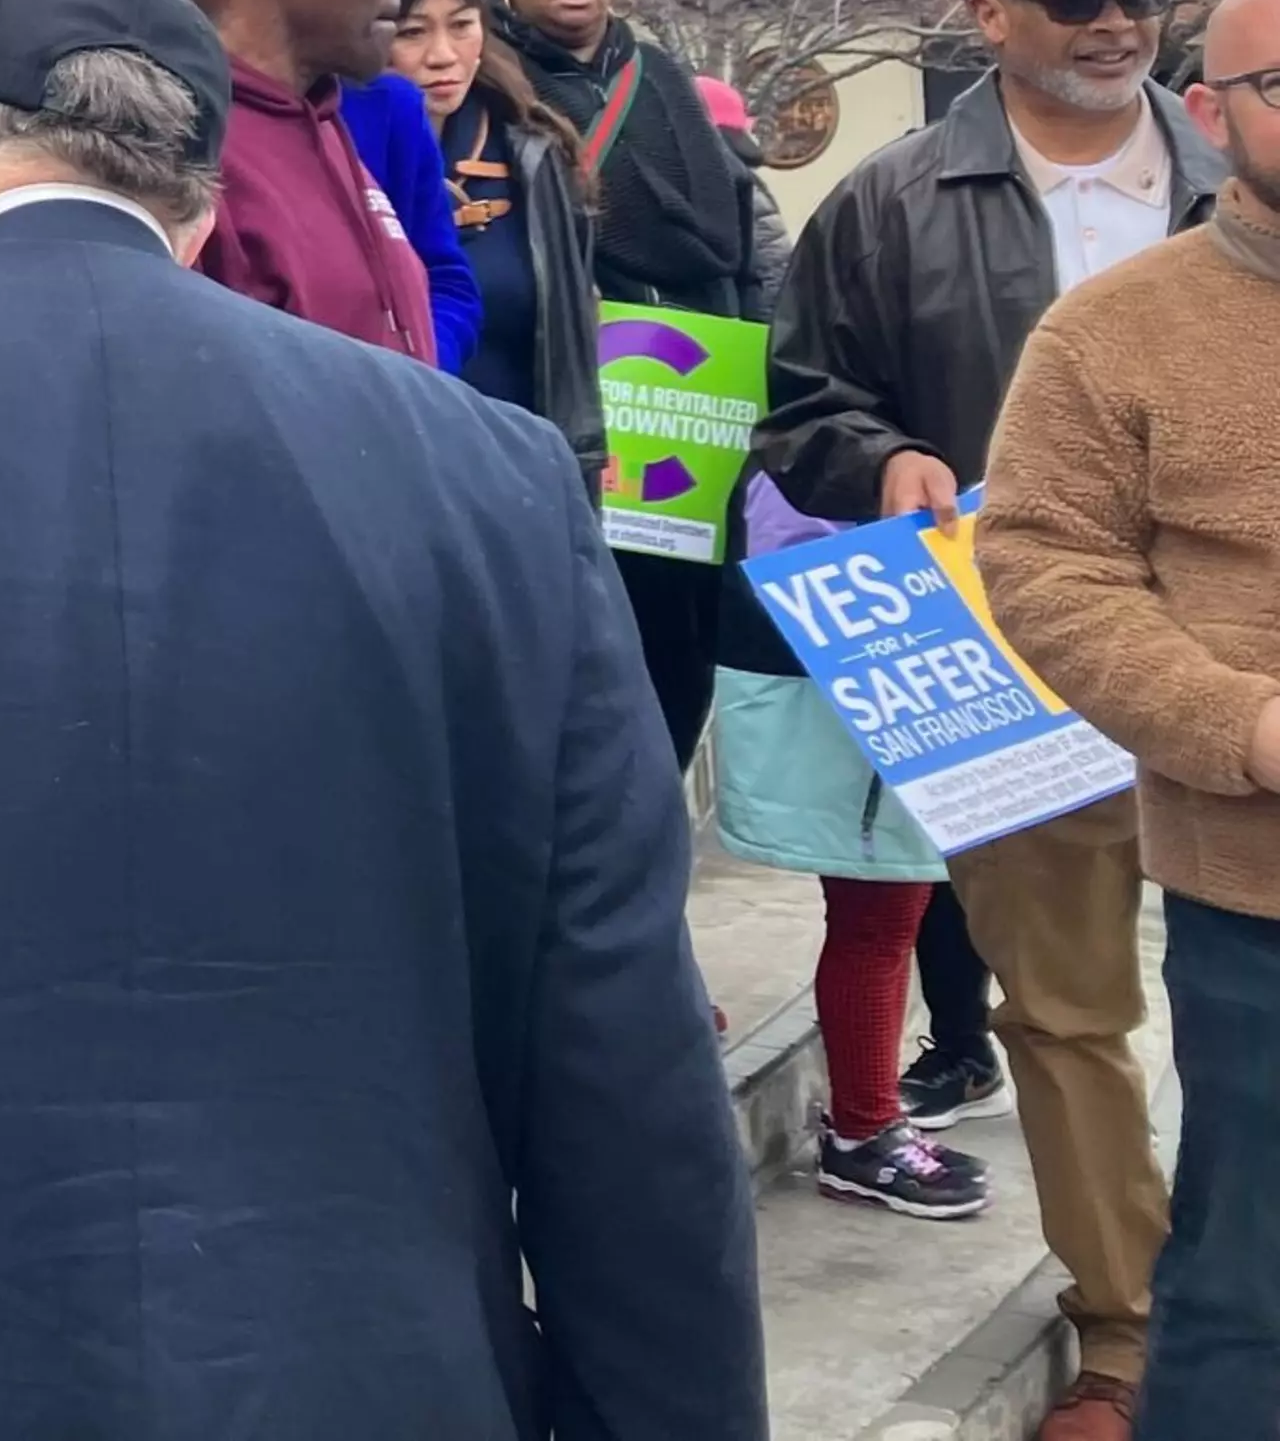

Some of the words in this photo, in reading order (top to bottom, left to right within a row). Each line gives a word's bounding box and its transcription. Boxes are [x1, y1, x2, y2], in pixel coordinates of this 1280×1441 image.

[601, 379, 633, 403] FOR
[636, 385, 651, 405] A
[653, 386, 758, 425] REVITALIZED
[761, 553, 911, 648] YES
[903, 567, 947, 597] ON
[831, 638, 1014, 732] SAFER
[863, 637, 903, 659] FOR
[904, 632, 919, 649] A
[866, 724, 924, 766] SAN
[913, 687, 1036, 751] FRANCISCO
